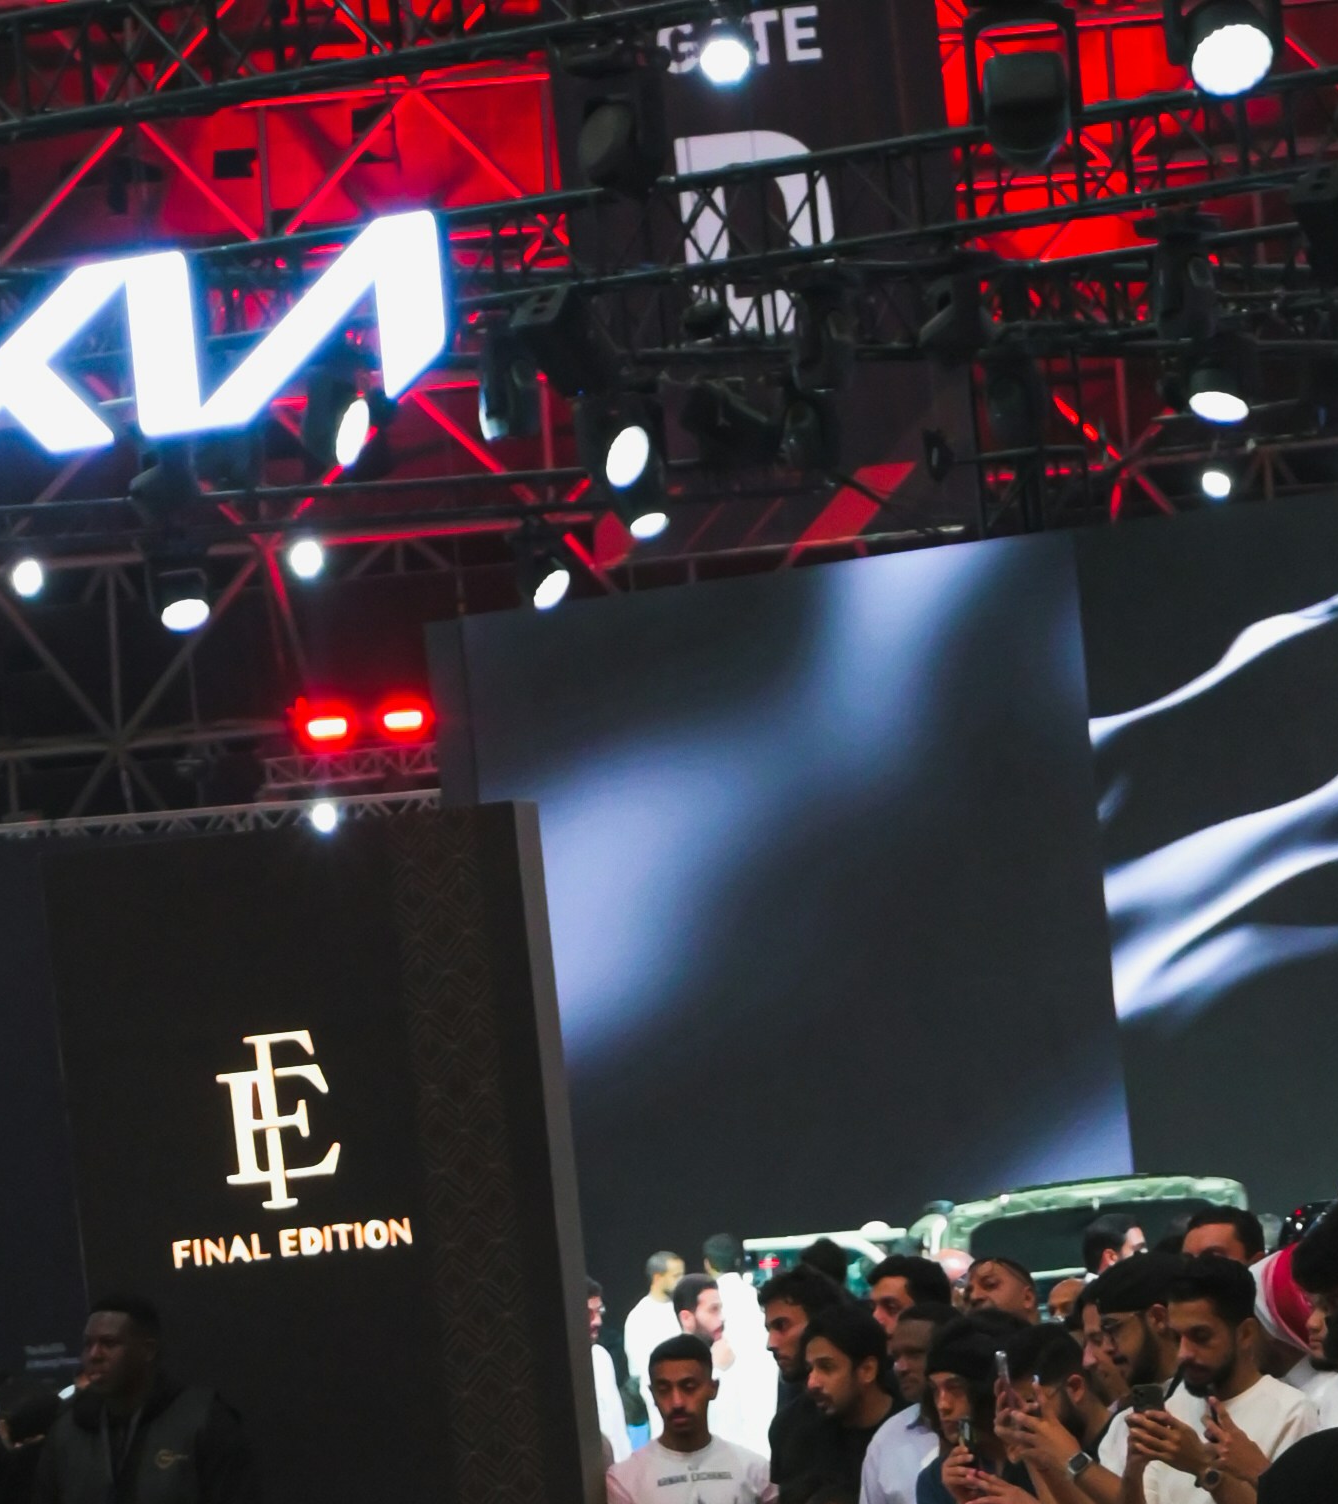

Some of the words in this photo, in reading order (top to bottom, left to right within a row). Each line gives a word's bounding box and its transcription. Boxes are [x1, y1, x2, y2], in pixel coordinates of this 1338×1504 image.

[657, 5, 823, 74] GTE
[173, 1233, 271, 1269] FINAL
[278, 1217, 413, 1258] EDITION
